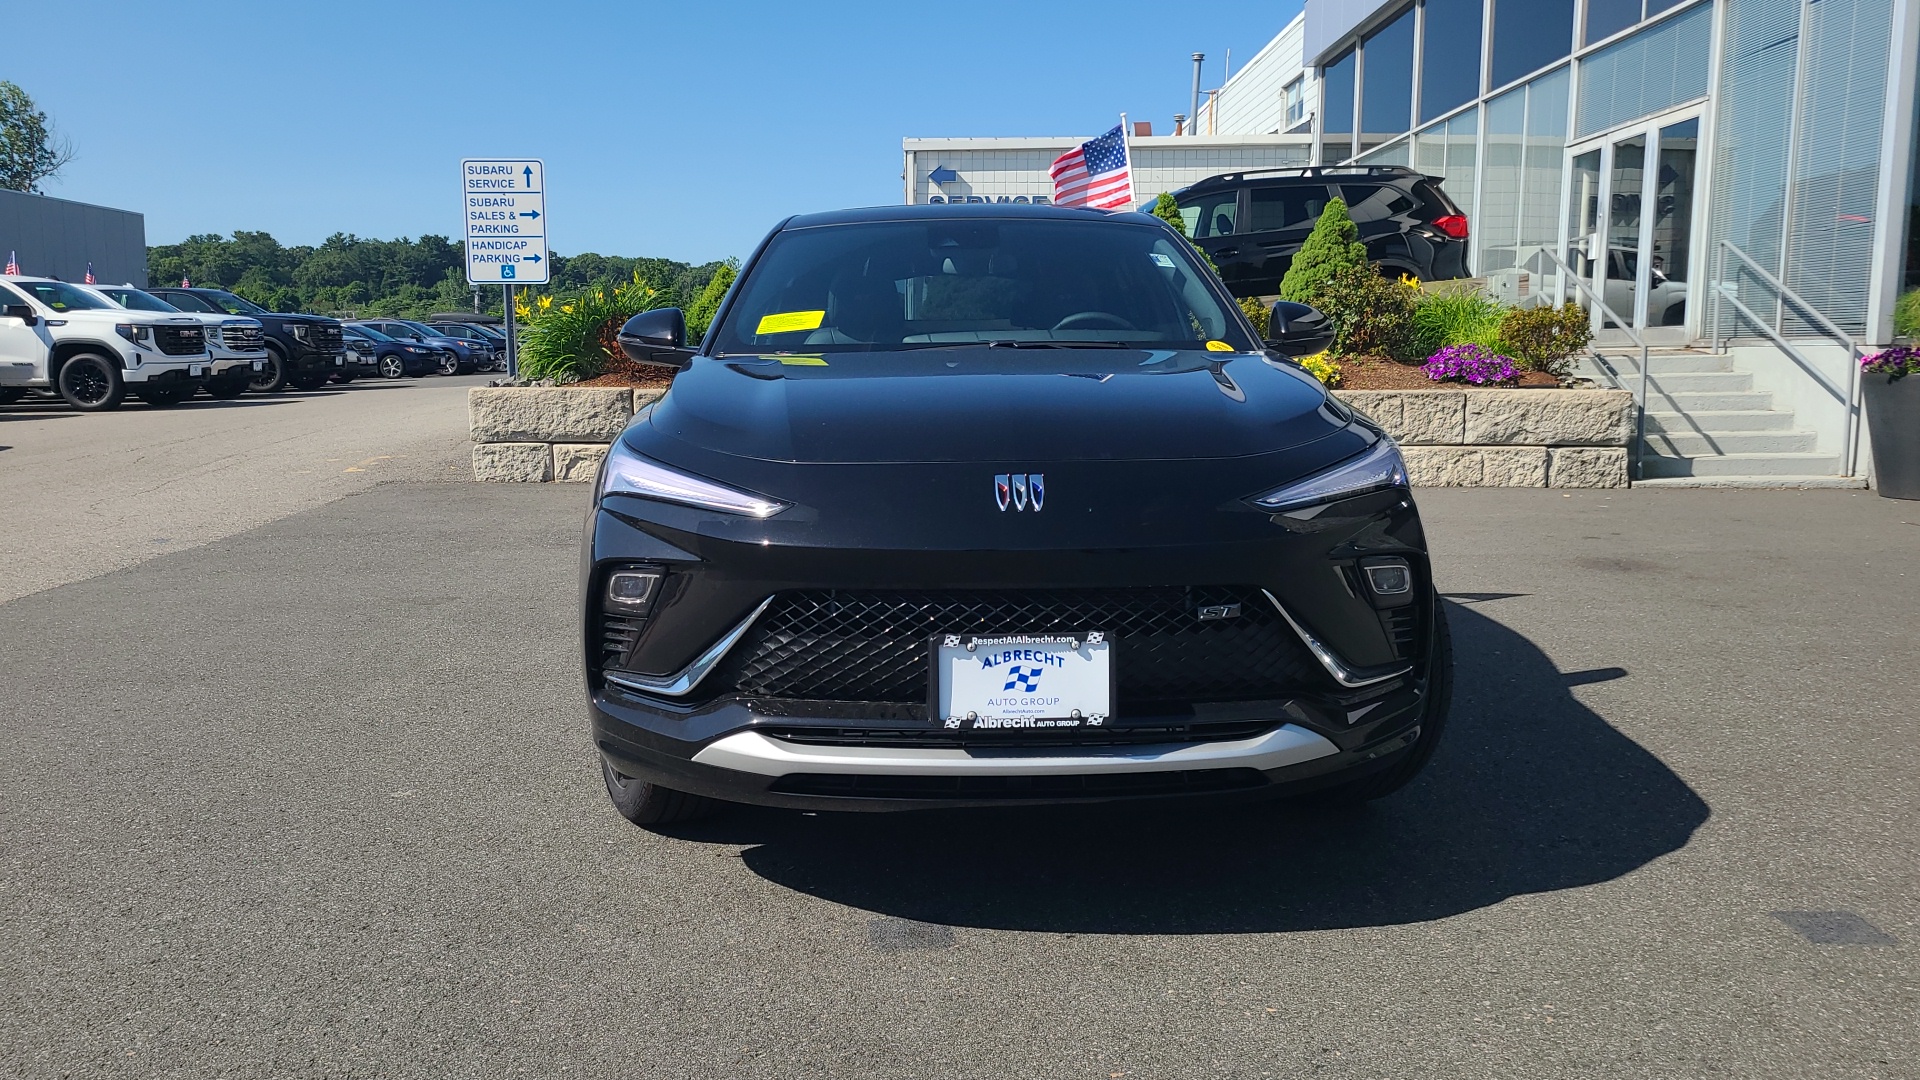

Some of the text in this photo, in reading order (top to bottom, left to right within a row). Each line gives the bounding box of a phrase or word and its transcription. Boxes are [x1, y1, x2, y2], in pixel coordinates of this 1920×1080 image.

[467, 165, 513, 175] SUBARU
[468, 179, 515, 189] SERVICE
[469, 198, 515, 207] SUBARU
[470, 211, 516, 221] SALES &
[471, 224, 519, 234] PARKING
[472, 241, 528, 250] HANDICAP
[472, 254, 521, 263] PARKING
[972, 635, 1076, 647] RespectAtAlbrecht.com
[981, 649, 1065, 670] ALBRECHT
[987, 697, 1060, 706] AUTO GROUP
[973, 715, 1036, 729] Albrecht
